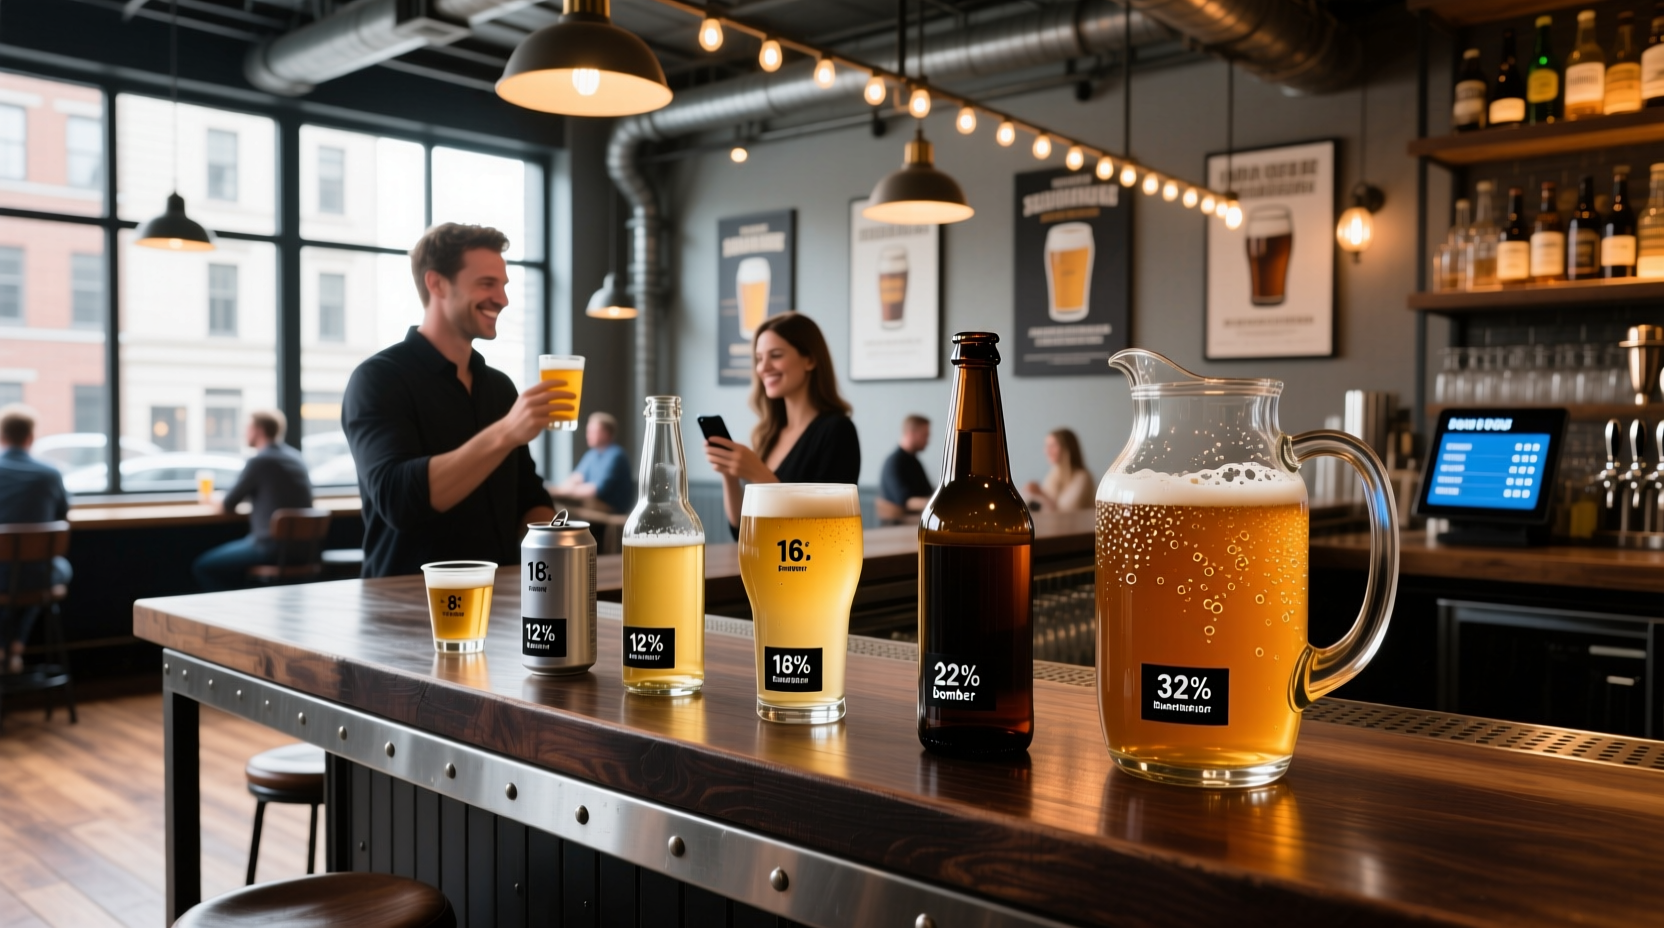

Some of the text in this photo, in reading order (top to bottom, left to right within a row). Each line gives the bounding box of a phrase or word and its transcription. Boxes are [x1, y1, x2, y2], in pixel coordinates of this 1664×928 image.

[526, 623, 555, 642] 12%
[630, 633, 663, 652] 12%
[773, 655, 811, 675] 18%
[934, 661, 980, 686] 22%
[1157, 674, 1211, 699] 32%
